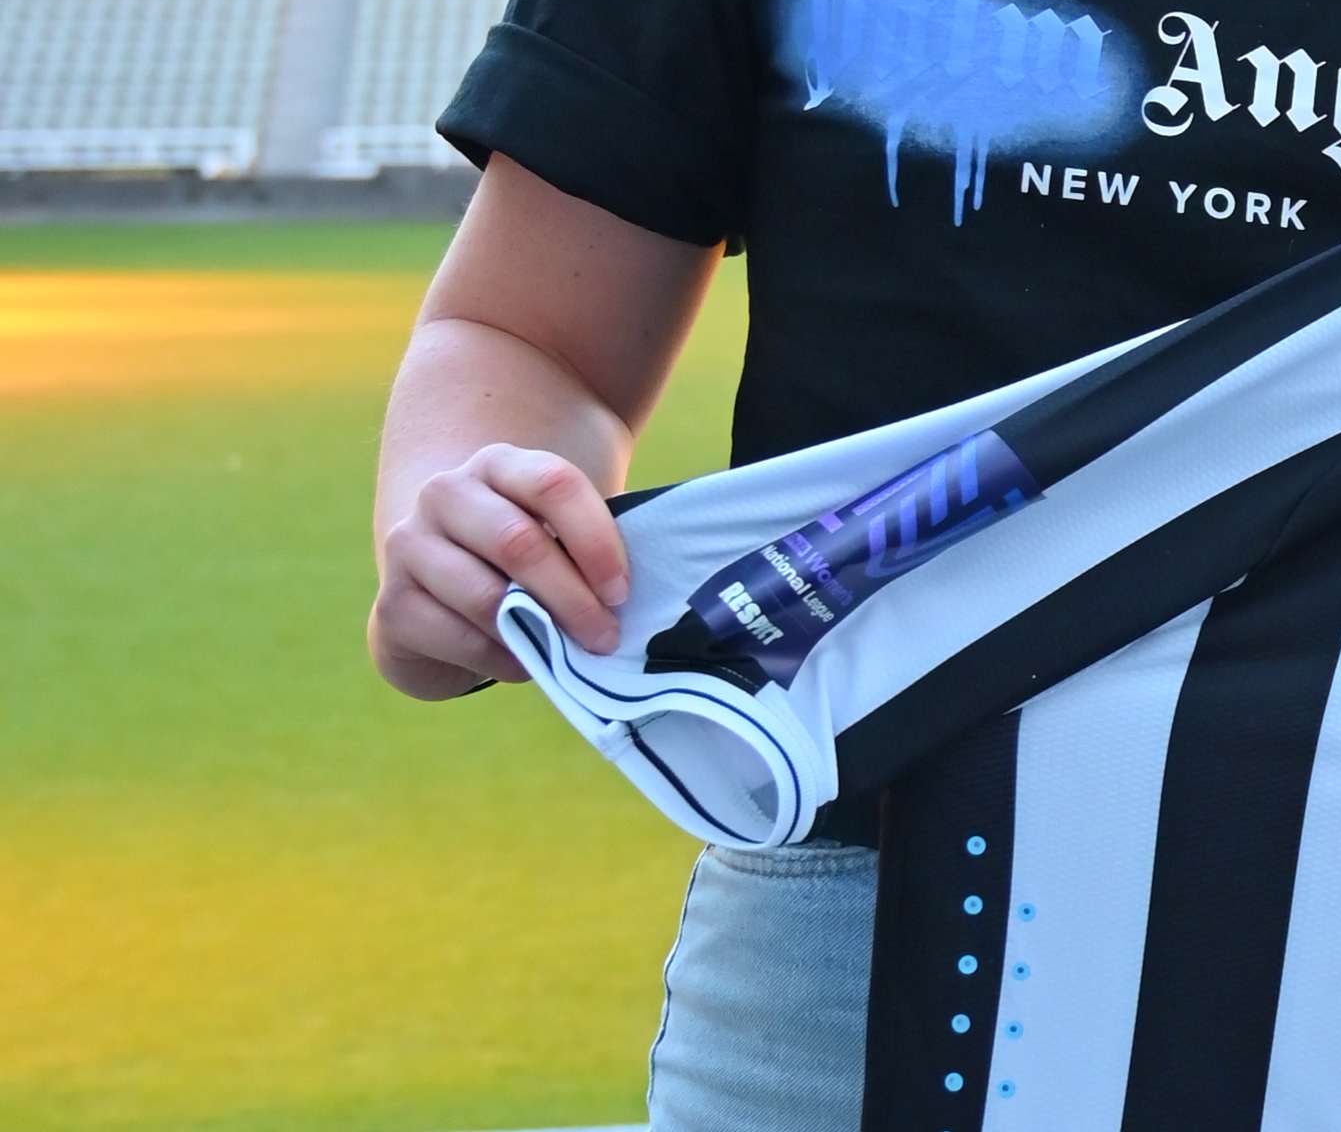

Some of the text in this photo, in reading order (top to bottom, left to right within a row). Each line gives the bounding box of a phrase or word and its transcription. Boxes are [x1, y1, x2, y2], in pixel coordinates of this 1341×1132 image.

[1020, 161, 1310, 231] NEW YORK
[759, 544, 812, 596] National
[802, 590, 835, 623] League
